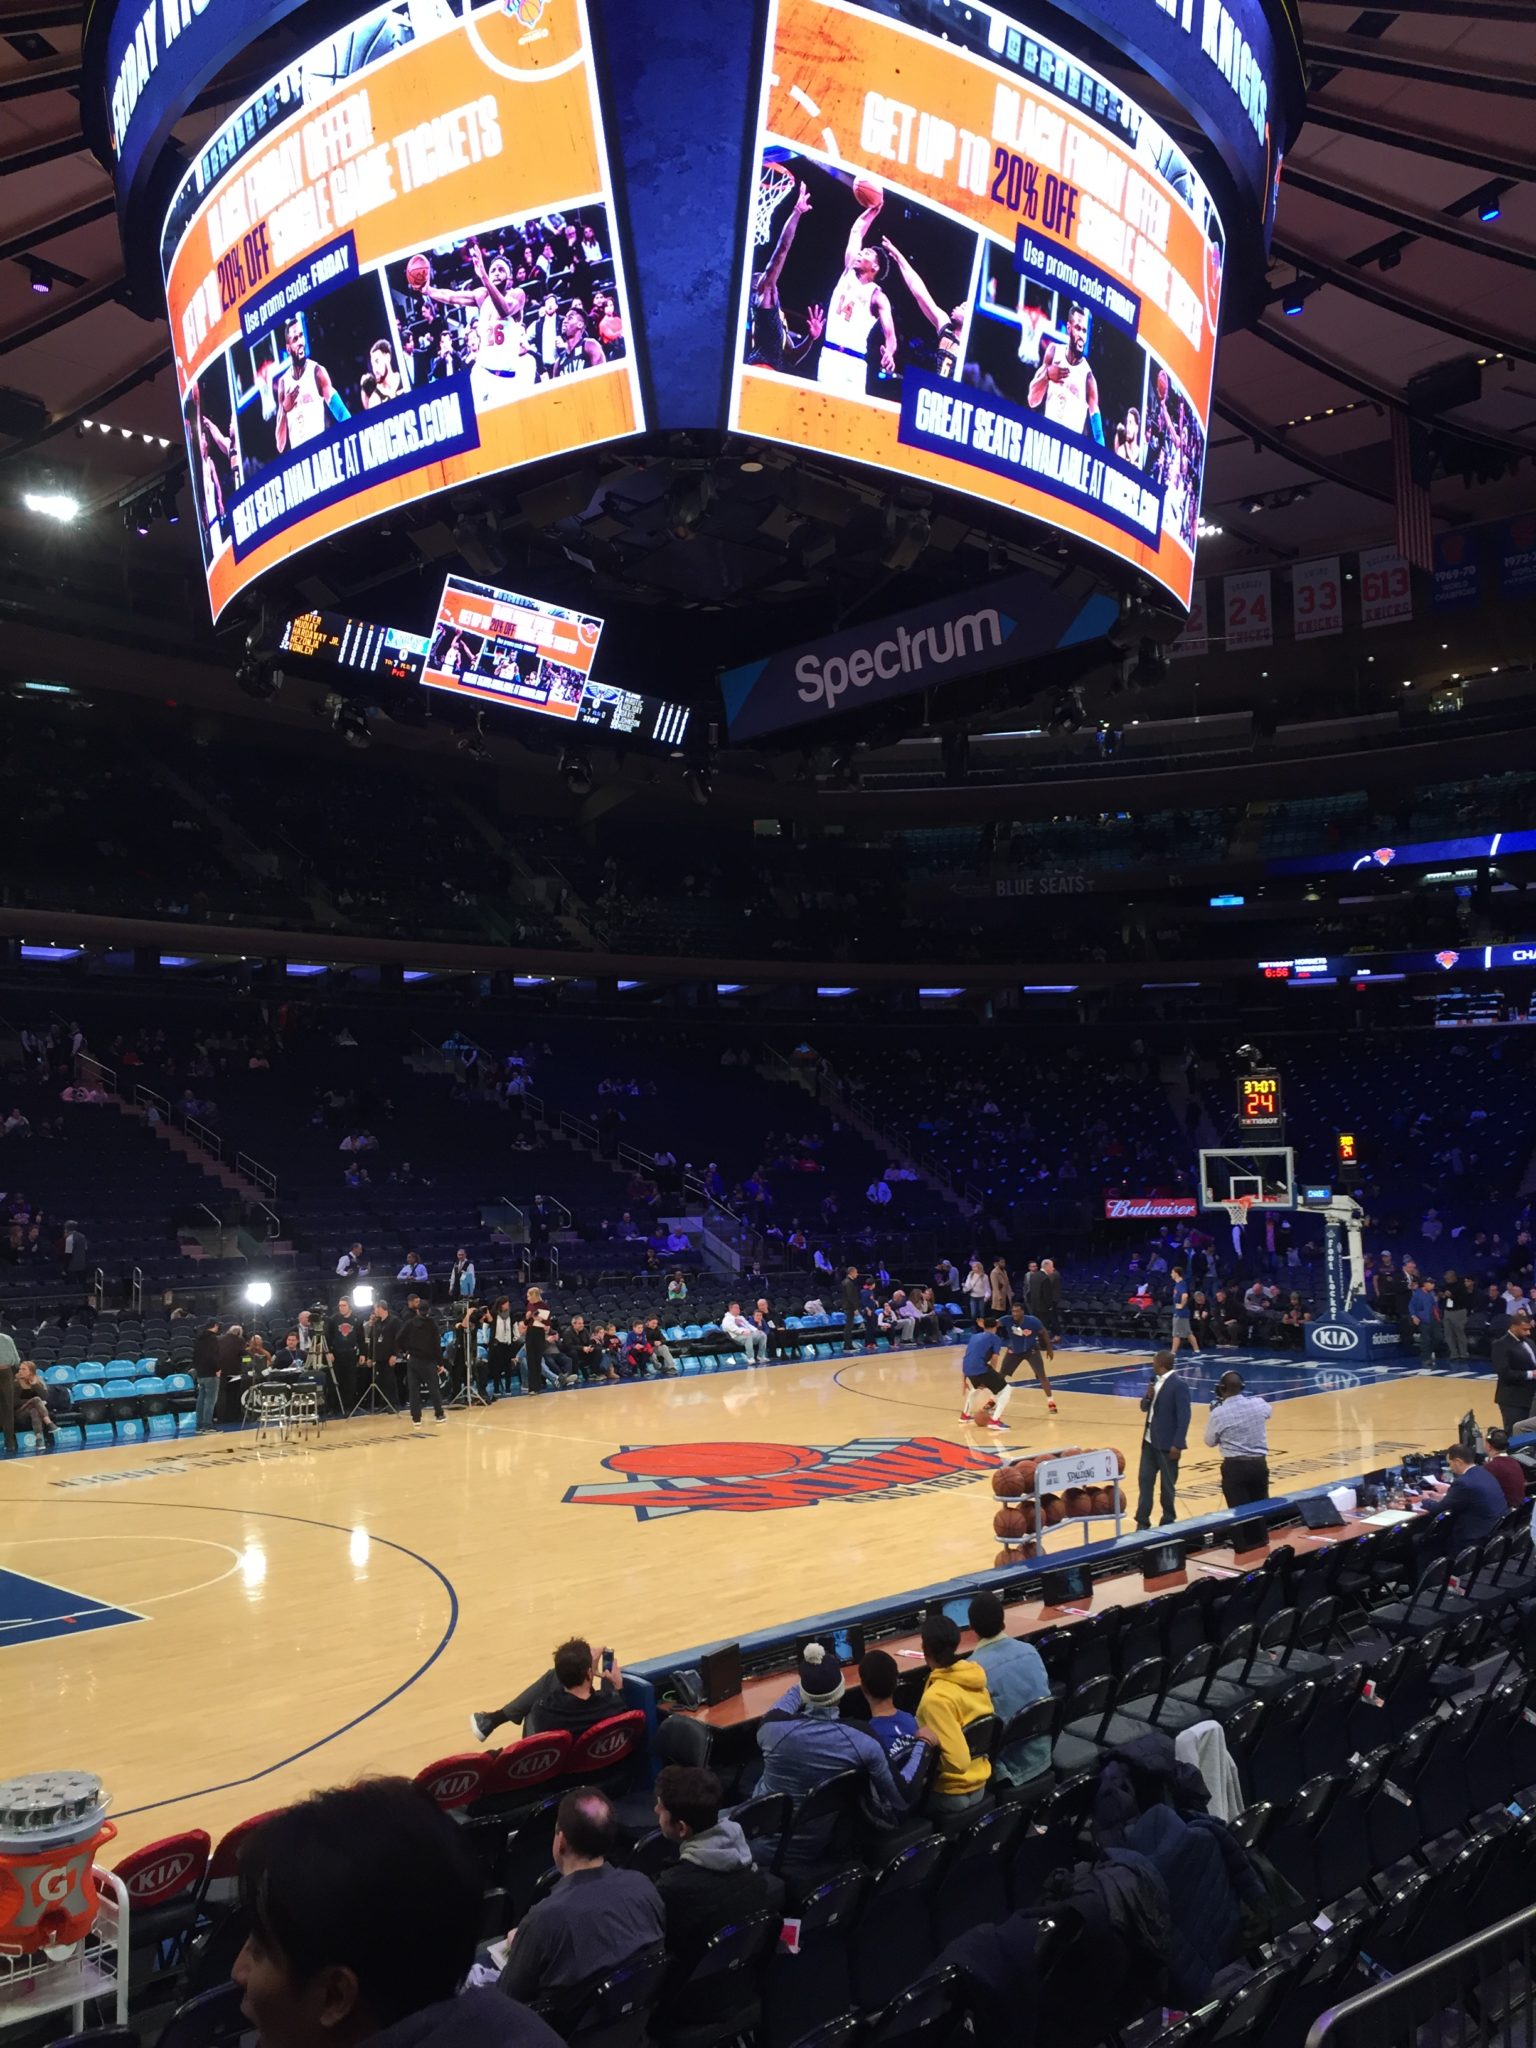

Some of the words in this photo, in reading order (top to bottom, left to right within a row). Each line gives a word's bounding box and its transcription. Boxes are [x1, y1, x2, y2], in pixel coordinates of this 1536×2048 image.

[112, 0, 158, 162] FRIDAY
[1202, 0, 1267, 147] KNICKS
[860, 90, 917, 165] GET
[915, 111, 956, 179] UP
[957, 128, 991, 197] TO
[990, 146, 1039, 221] 20%
[1042, 173, 1078, 240] OFF
[217, 247, 246, 313] 20%
[243, 221, 269, 287] OFF
[393, 95, 502, 193] TICKETS
[1023, 238, 1044, 269] Use
[1045, 254, 1079, 288] promo
[1079, 272, 1106, 305] code:
[244, 307, 260, 335] Use
[259, 287, 285, 326] promo
[285, 272, 312, 304] code:
[311, 245, 350, 288] FRIDAY
[282, 441, 345, 511] AVAILABLE
[343, 433, 361, 479] AT
[359, 392, 464, 471] KNICKS.COM
[915, 388, 974, 445] GREAT
[972, 407, 1023, 464] SEATS
[1020, 427, 1092, 494] AVAILABLE
[1089, 458, 1105, 500] AT
[1363, 567, 1409, 601] 613
[1434, 565, 1476, 582] 1969-70
[1297, 581, 1337, 614] 33
[1229, 595, 1267, 626] 24
[290, 634, 319, 649] HEZONJA
[292, 626, 328, 643] HARDAWAY
[795, 608, 1002, 708] Spectrum
[996, 879, 1034, 897] BLUE
[1039, 875, 1085, 895] SEATS
[1264, 968, 1289, 978] 6:56
[1244, 1080, 1276, 1094] 37:07
[1248, 1094, 1273, 1114] 24
[1107, 1199, 1196, 1217] Budweiser
[1319, 1331, 1351, 1346] KIA
[50, 1466, 186, 1488] GARDEN
[562, 1437, 1004, 1512] KNICKS
[922, 1471, 989, 1490] NEW
[1067, 1467, 1095, 1483] SPALDING
[824, 1487, 938, 1504] YORK
[594, 1733, 627, 1756] KIA
[517, 1754, 552, 1774] KIA
[434, 1776, 472, 1795] KIA
[38, 1866, 68, 1900] G
[137, 1859, 184, 1892] KIA
